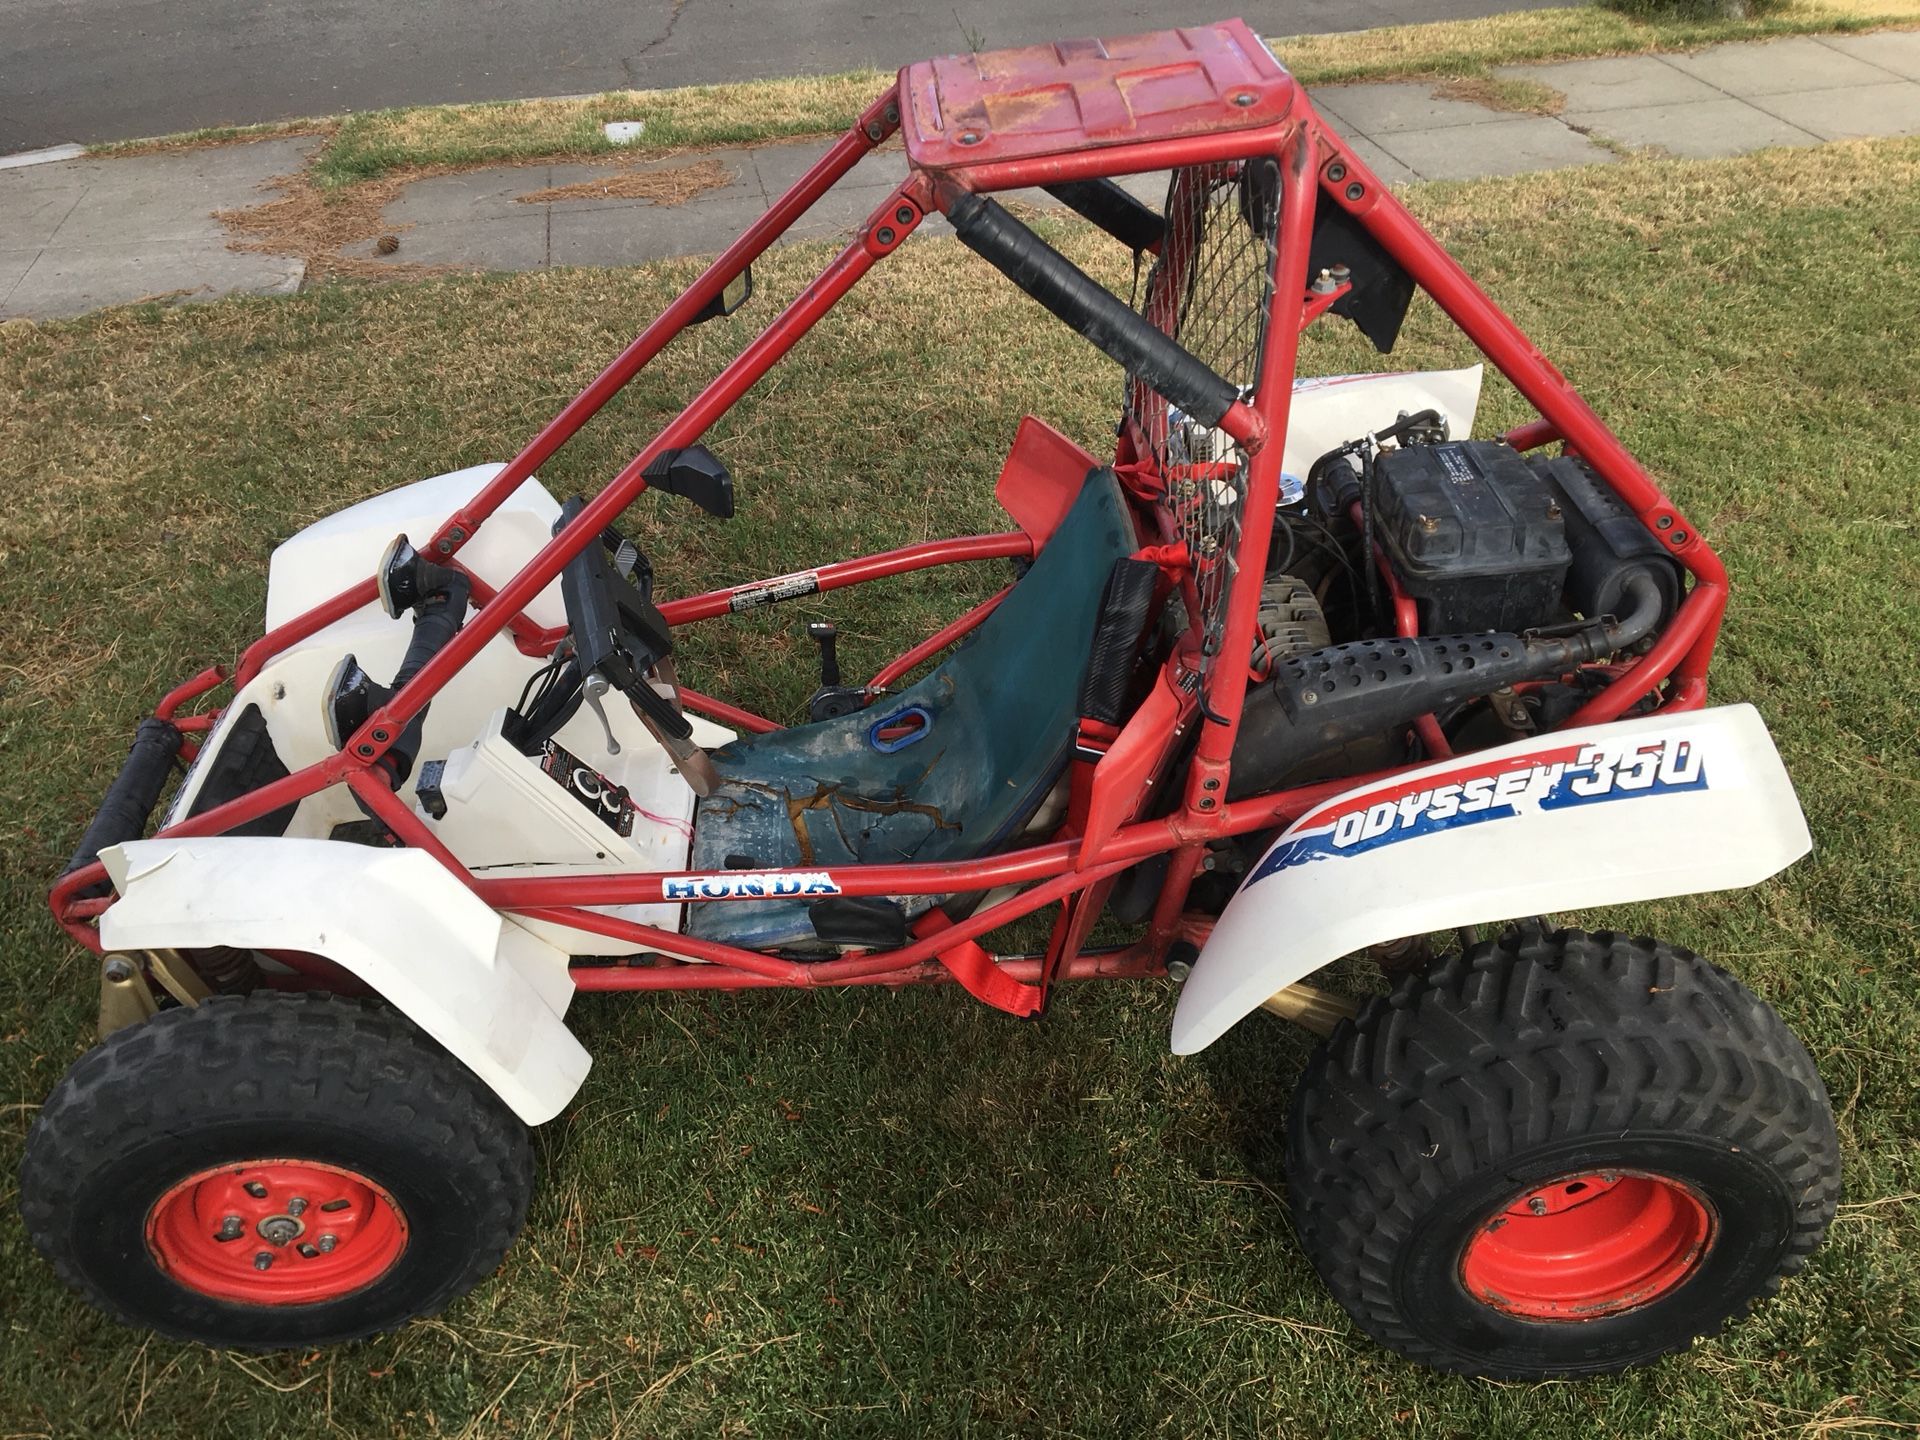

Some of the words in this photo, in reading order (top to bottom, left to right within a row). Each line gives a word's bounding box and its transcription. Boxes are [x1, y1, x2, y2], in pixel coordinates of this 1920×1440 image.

[1331, 760, 1566, 849] ODYSSEY
[1569, 733, 1704, 797] 350
[664, 872, 841, 900] HONDA
